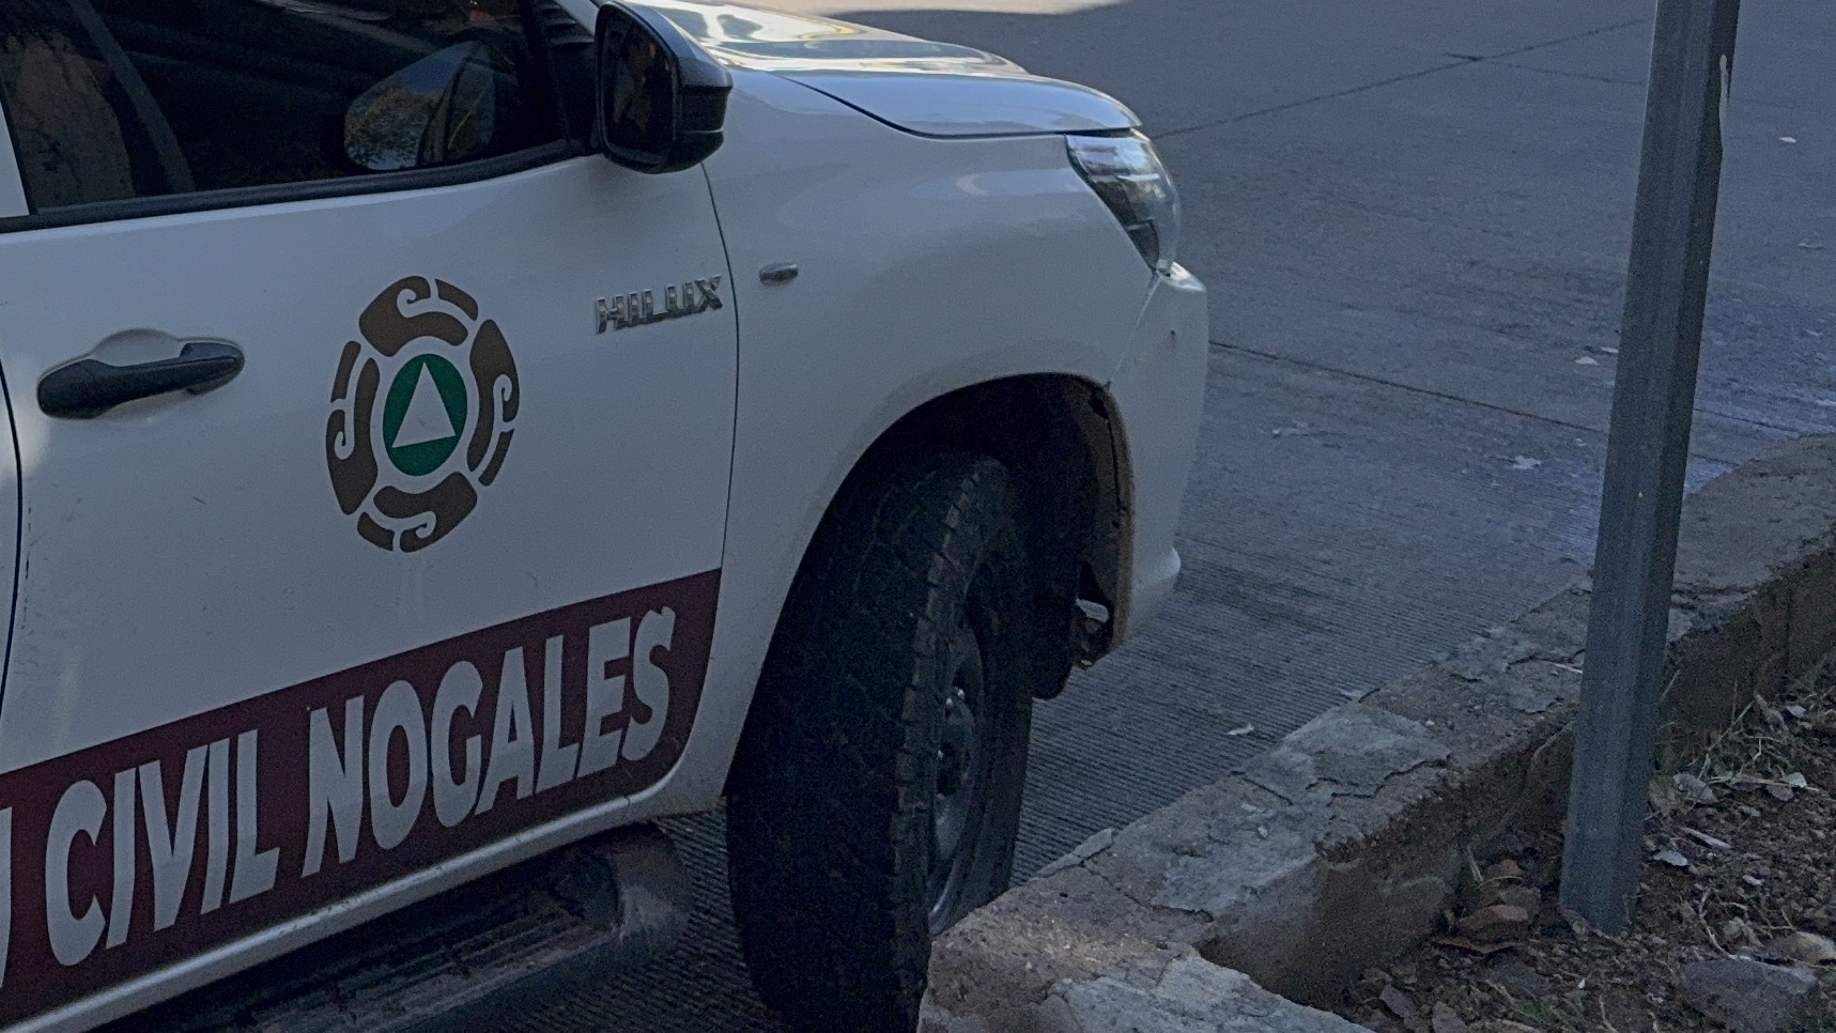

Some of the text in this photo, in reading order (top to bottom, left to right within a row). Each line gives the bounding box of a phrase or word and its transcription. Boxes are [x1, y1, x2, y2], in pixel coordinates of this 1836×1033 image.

[595, 275, 724, 334] HILUX
[45, 728, 280, 967] CIVIL
[301, 606, 677, 878] NOGALES
